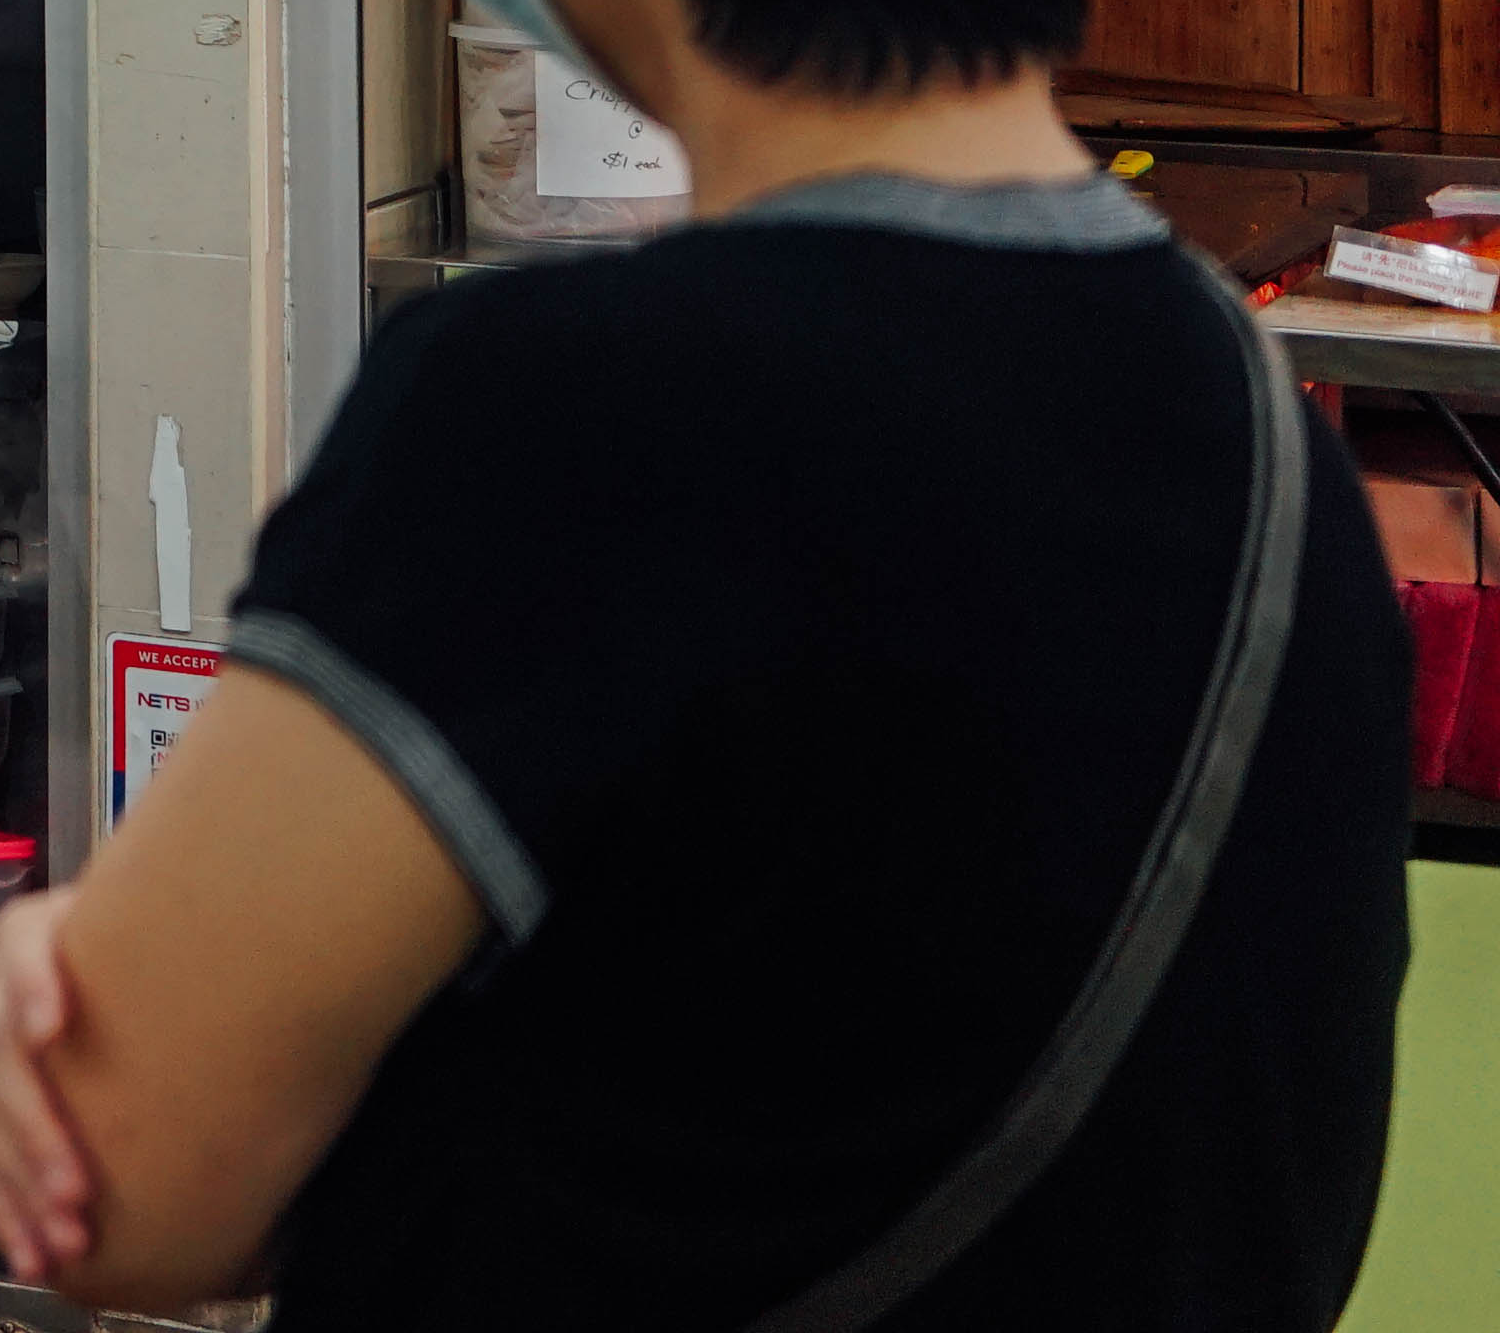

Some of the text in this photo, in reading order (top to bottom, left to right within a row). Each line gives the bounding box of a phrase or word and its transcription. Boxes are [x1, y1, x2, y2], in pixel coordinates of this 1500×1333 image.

[602, 151, 629, 170] $1
[138, 650, 218, 671] WE ACCEPT
[137, 692, 191, 712] NETS
